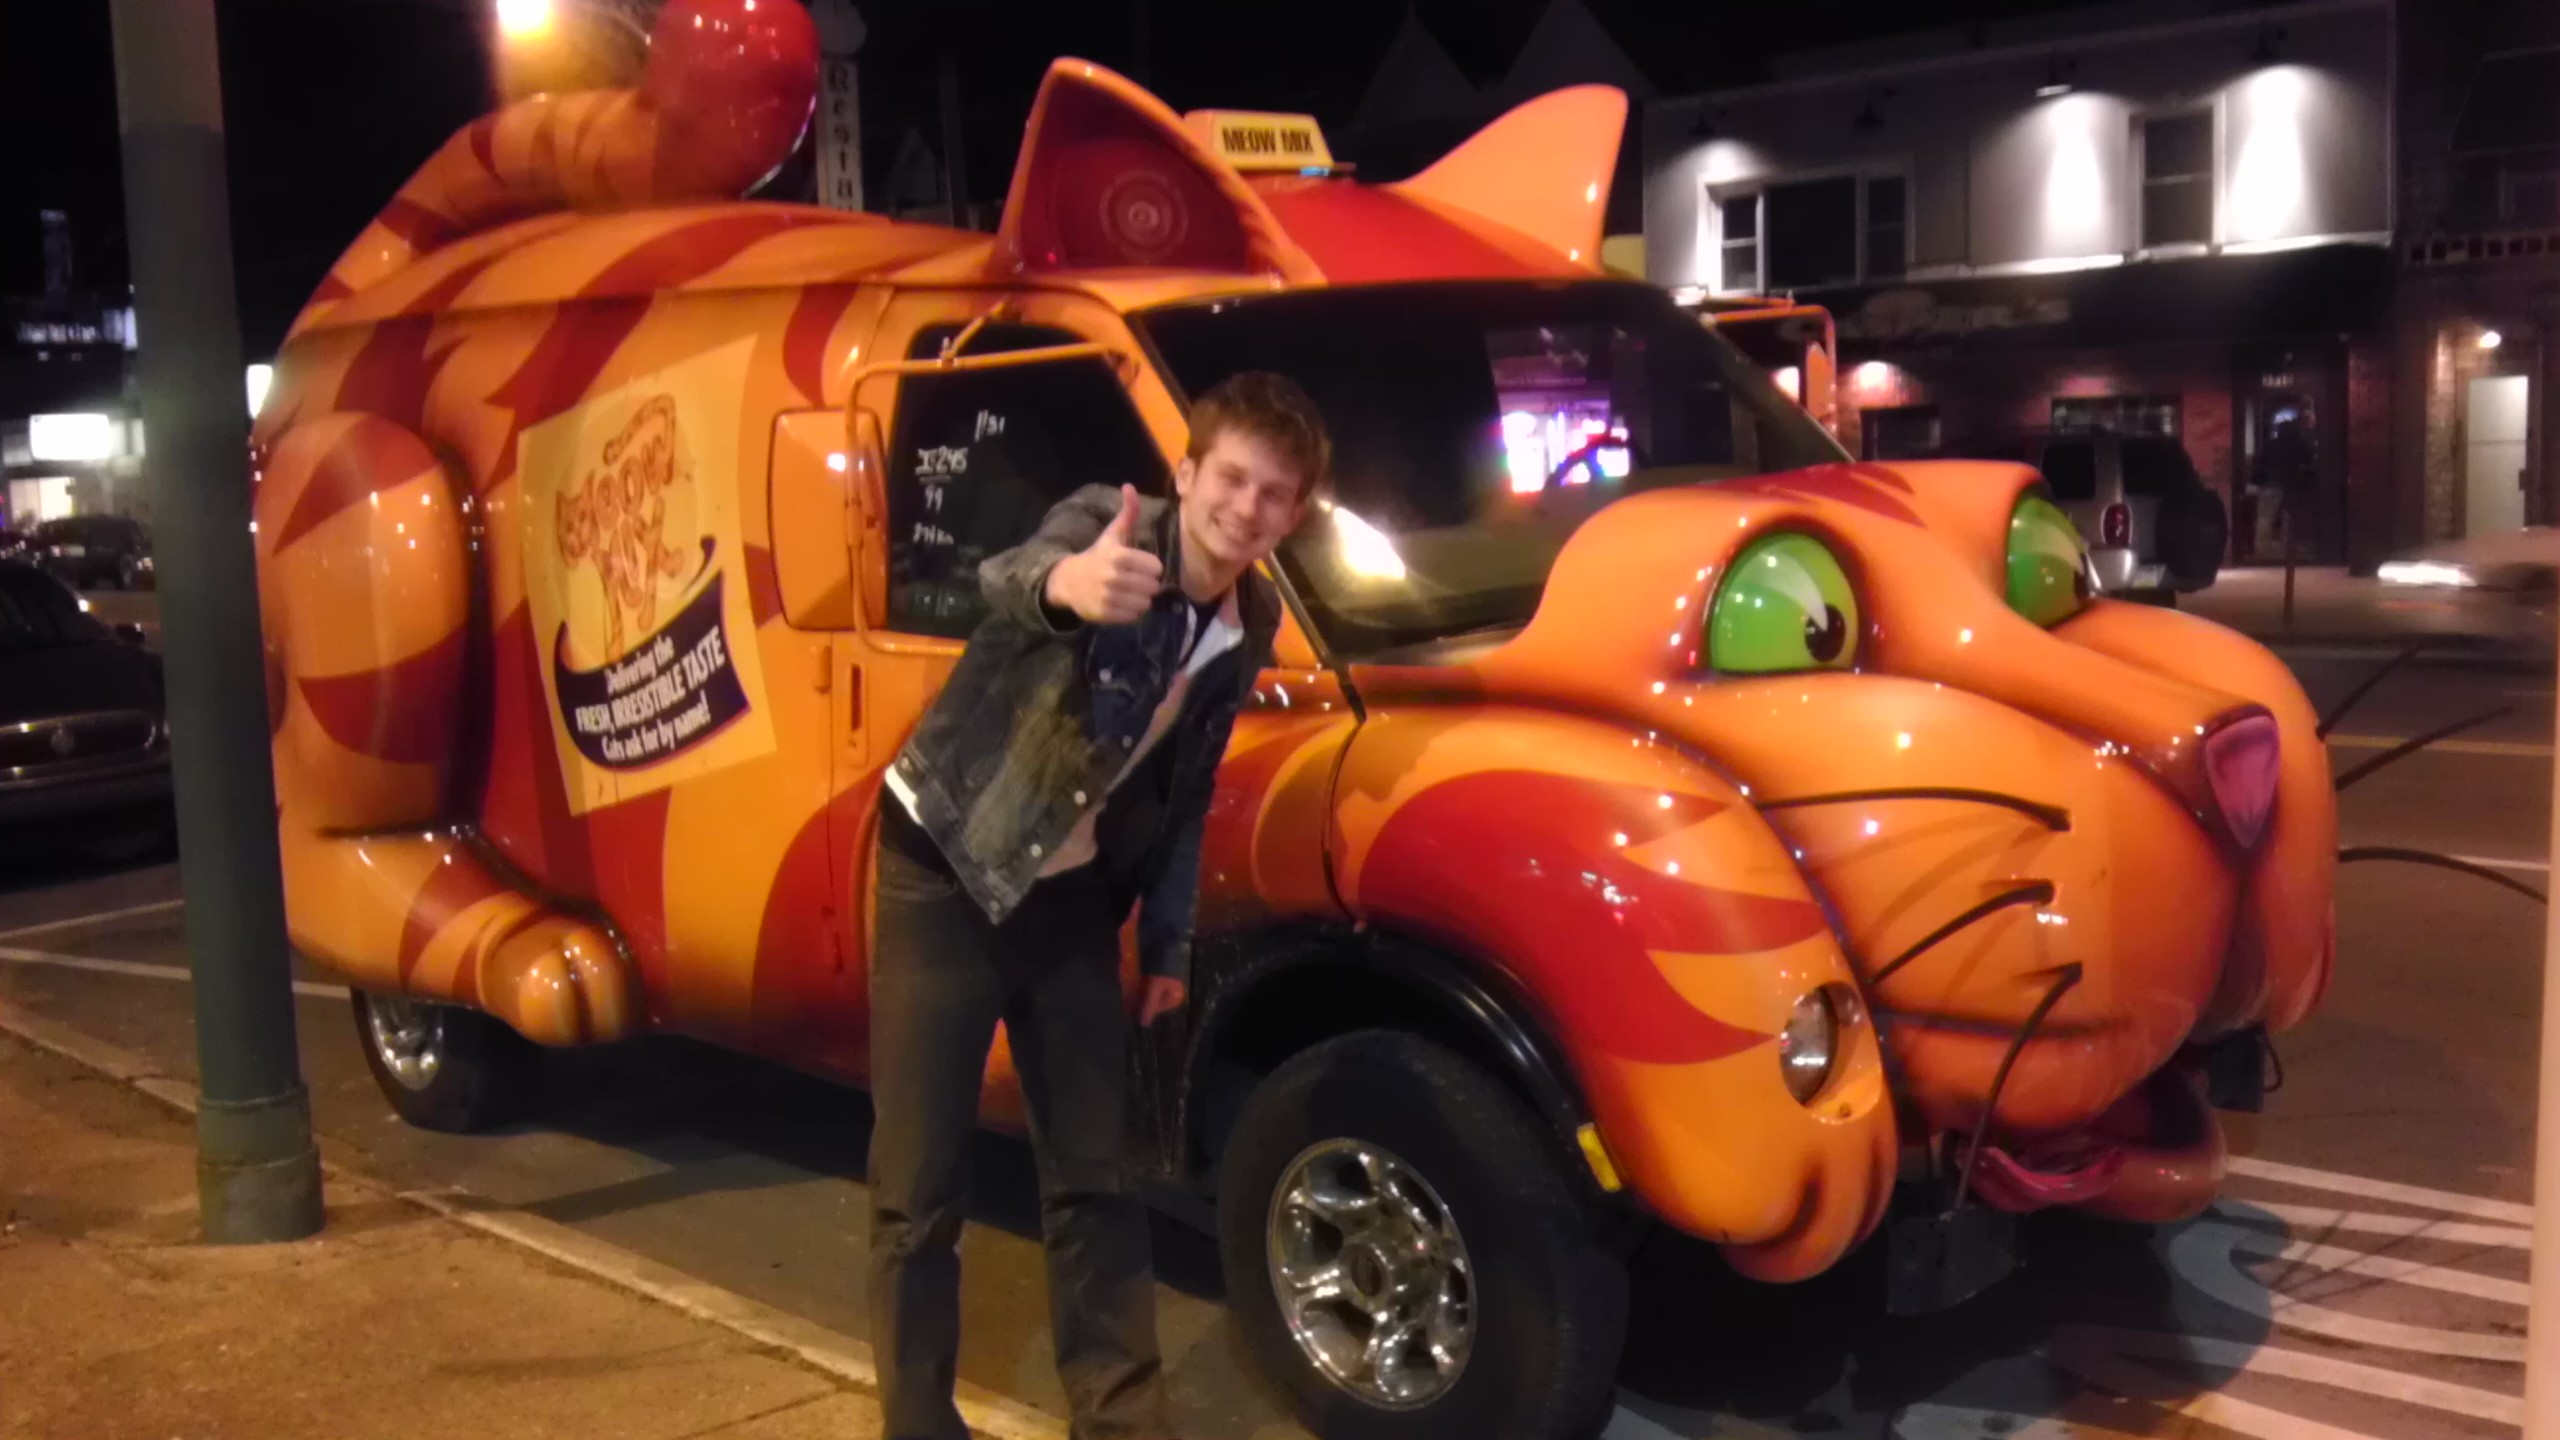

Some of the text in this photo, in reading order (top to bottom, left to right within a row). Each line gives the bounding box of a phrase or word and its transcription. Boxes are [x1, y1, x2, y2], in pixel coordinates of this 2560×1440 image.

[1222, 126, 1315, 153] MEOW MIX
[575, 625, 726, 734] FRESH, IRRESISTIBLE TASTE
[603, 633, 675, 696] Delivering the
[601, 689, 712, 762] Cats ask for by name!
